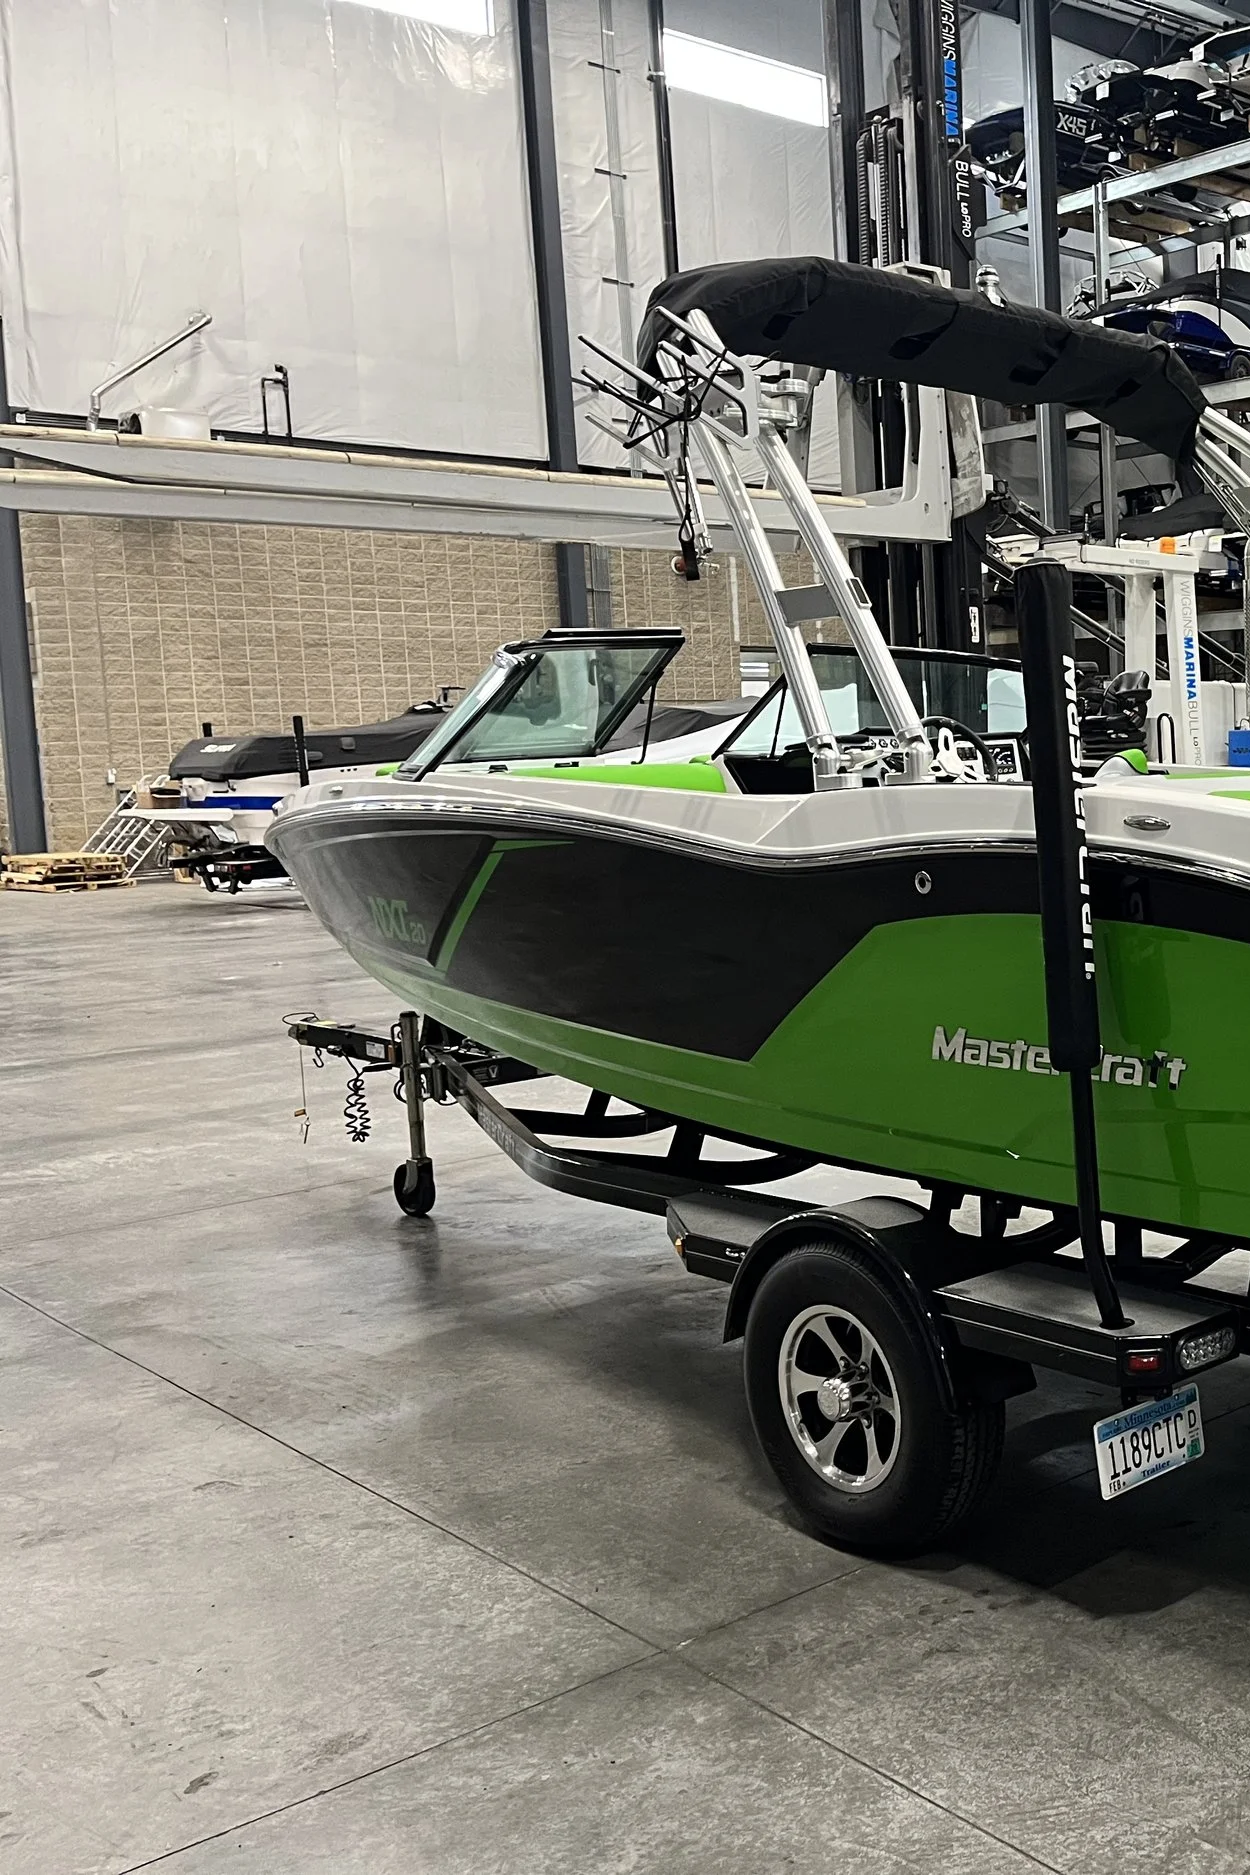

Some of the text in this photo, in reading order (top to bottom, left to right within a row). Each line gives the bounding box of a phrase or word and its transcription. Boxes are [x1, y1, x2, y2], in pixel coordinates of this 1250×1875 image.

[955, 160, 970, 201] BULL
[1183, 637, 1197, 700] MARINA
[931, 1025, 1187, 1091] Masteraft
[1107, 1412, 1186, 1481] 1189CTC
[1187, 1409, 1197, 1429] D
[1141, 1460, 1171, 1478] Trailer
[1109, 1479, 1122, 1494] FEB
